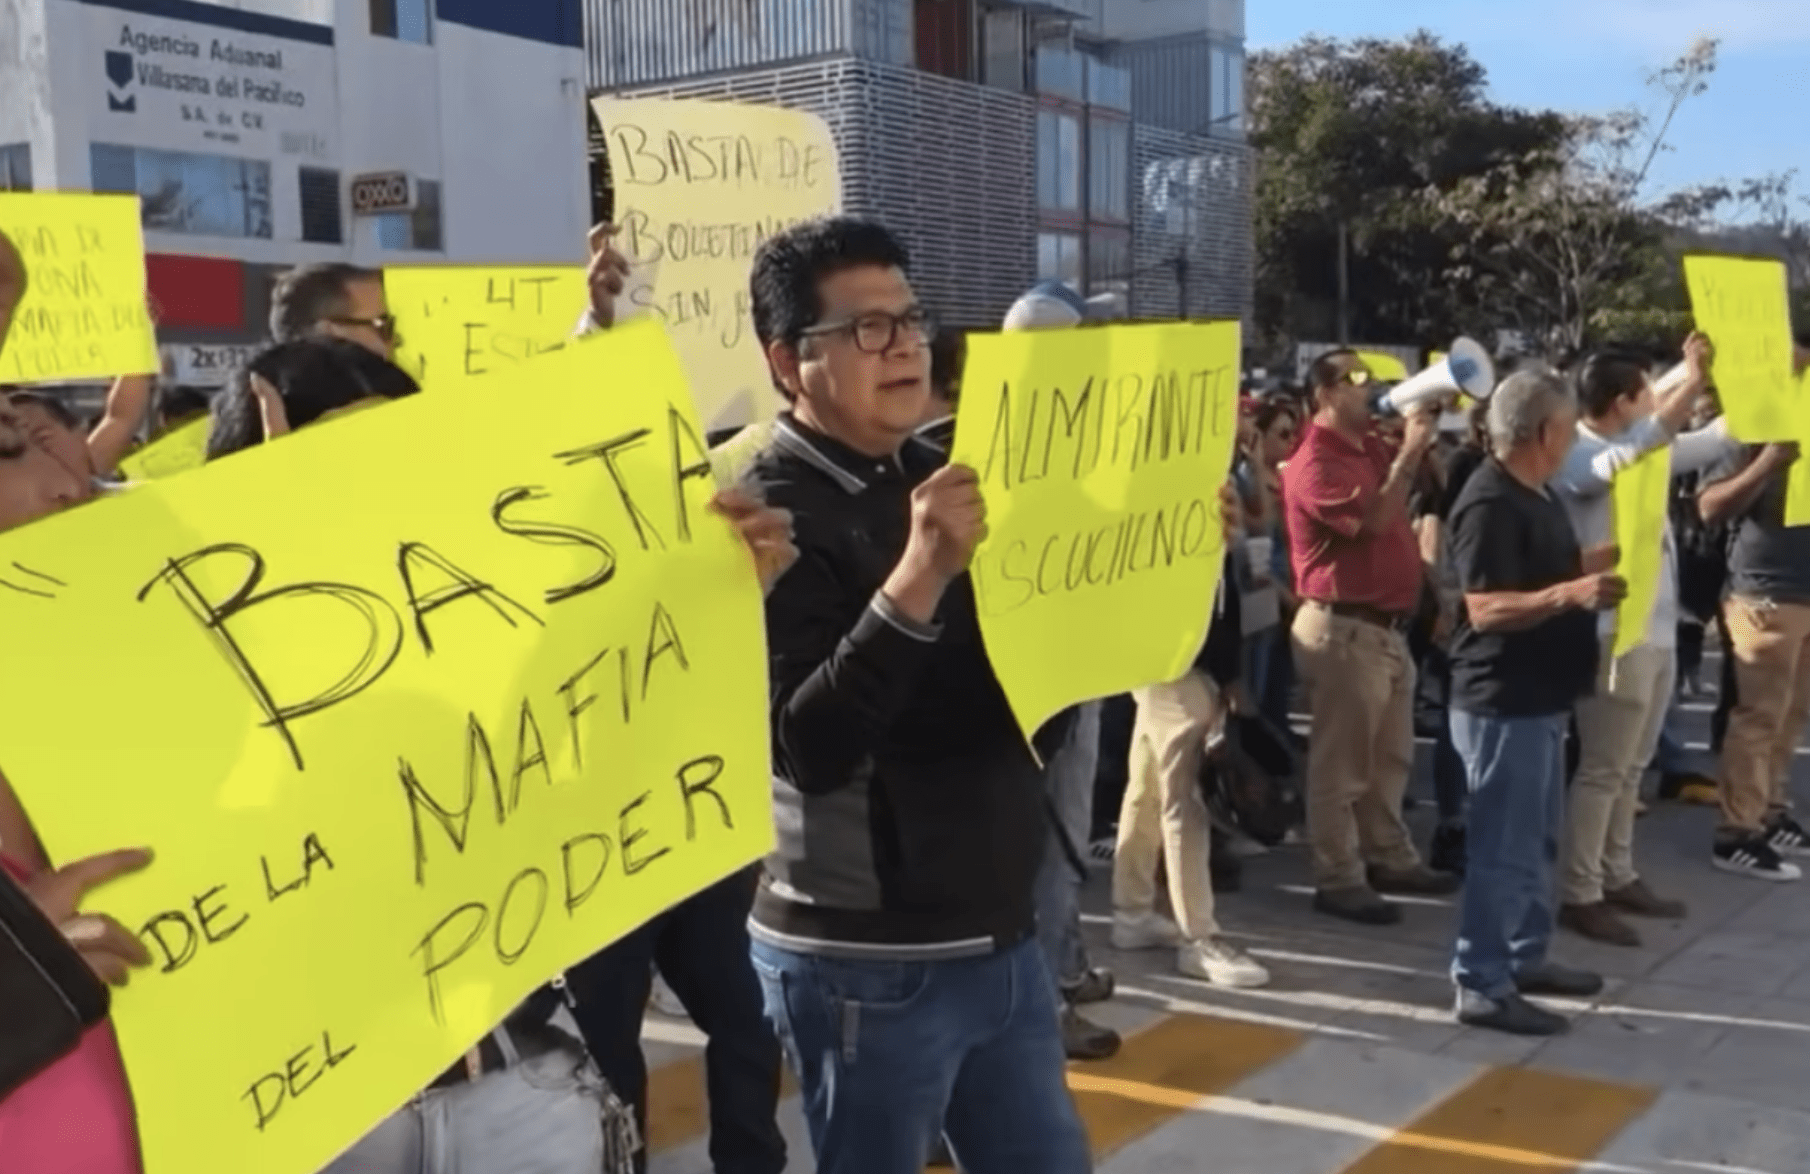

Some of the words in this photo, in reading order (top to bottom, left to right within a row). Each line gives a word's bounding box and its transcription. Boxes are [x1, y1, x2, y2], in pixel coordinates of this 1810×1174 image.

[120, 24, 200, 57] Agencia
[210, 38, 283, 70] Aduanal
[137, 61, 211, 95] Villasana
[215, 74, 240, 98] del
[611, 123, 759, 185] BASTA
[776, 135, 822, 188] DE
[486, 276, 562, 316] 4T
[630, 284, 711, 327] SIN
[984, 364, 1231, 490] ALMIRANTE
[138, 883, 250, 974] DE
[260, 831, 335, 902] LA
[398, 600, 690, 888] MAFIA
[240, 1029, 358, 1133] DEL
[409, 753, 734, 1028] PODER
